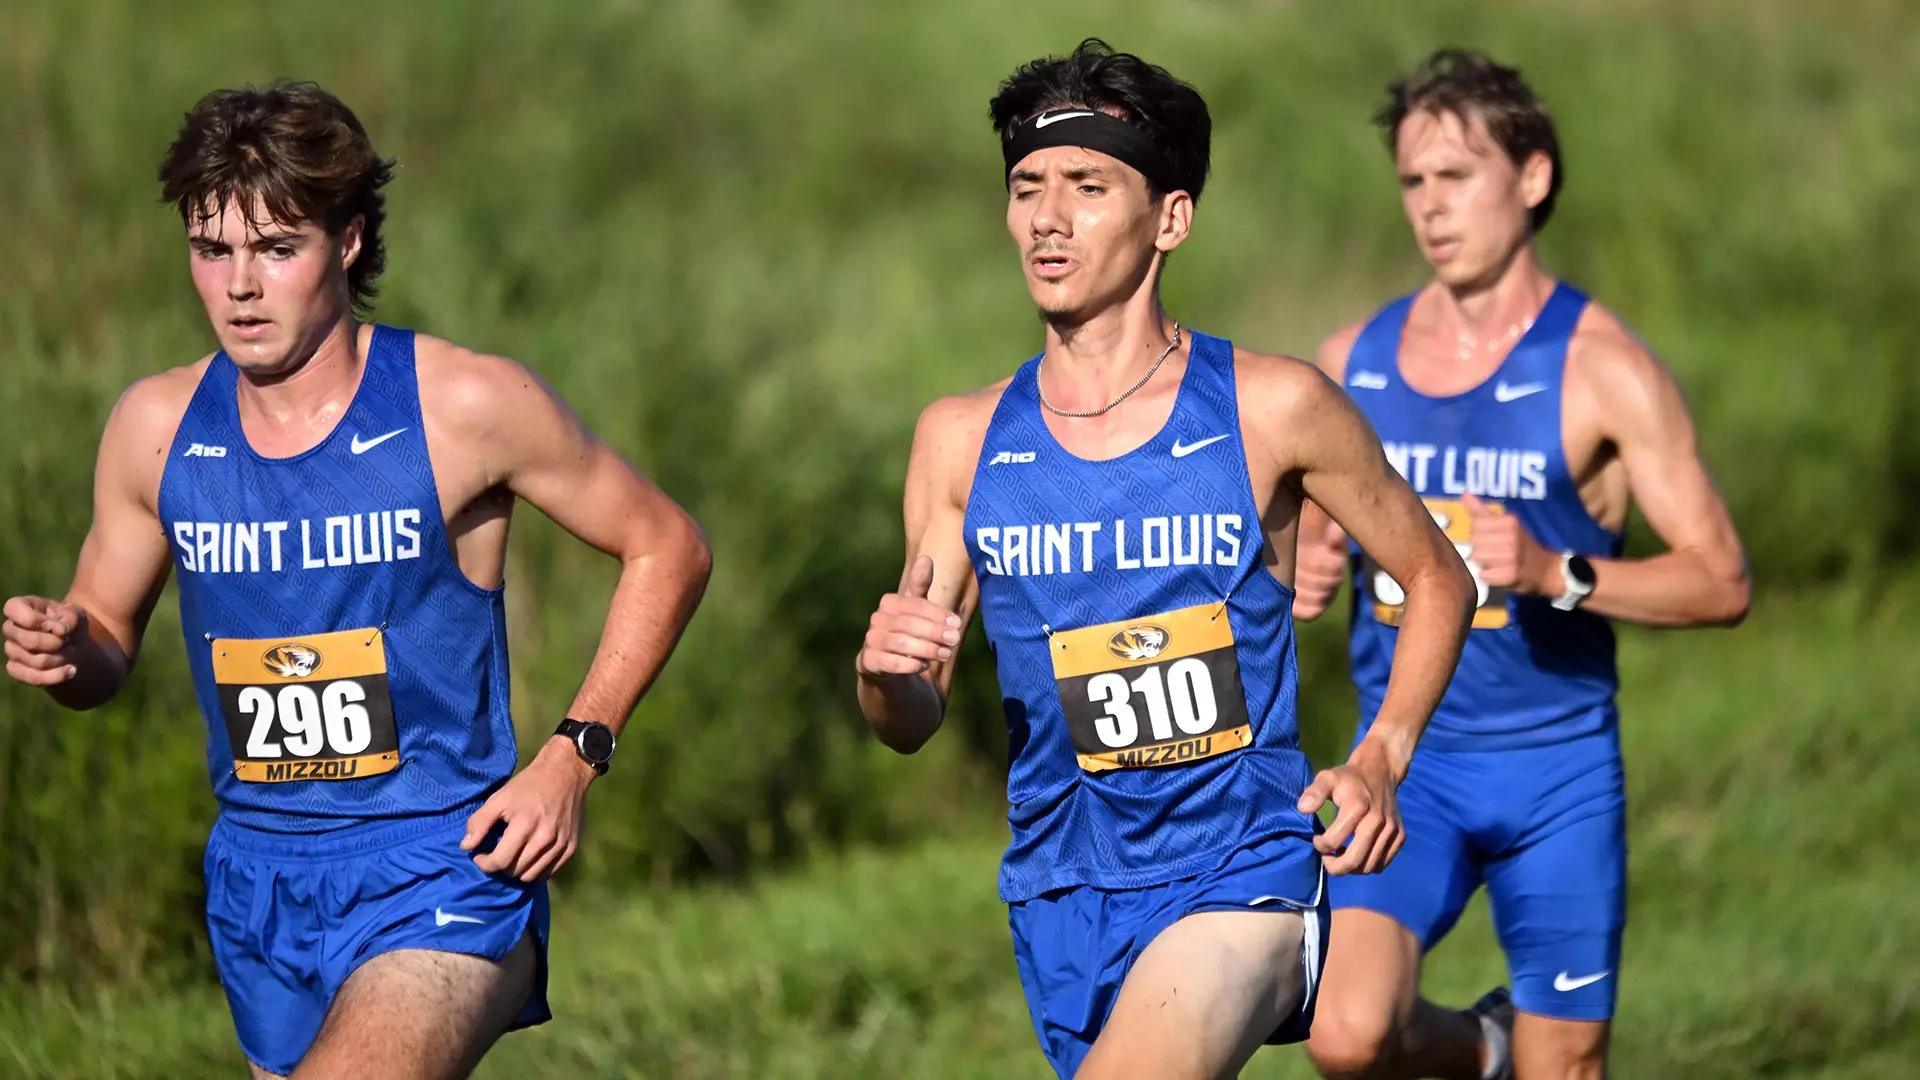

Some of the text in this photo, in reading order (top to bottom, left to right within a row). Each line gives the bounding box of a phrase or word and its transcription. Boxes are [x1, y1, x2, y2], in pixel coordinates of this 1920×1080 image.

[183, 443, 227, 458] A10
[989, 452, 1036, 466] A10
[1443, 445, 1548, 501] LOUIS
[173, 508, 421, 573] SAINT LOUIS
[976, 513, 1242, 576] SAINT LOUIS
[238, 680, 372, 758] 296
[1087, 657, 1218, 748] 310
[265, 759, 357, 781] MIZZOU
[1116, 736, 1212, 767] MIZZOU
